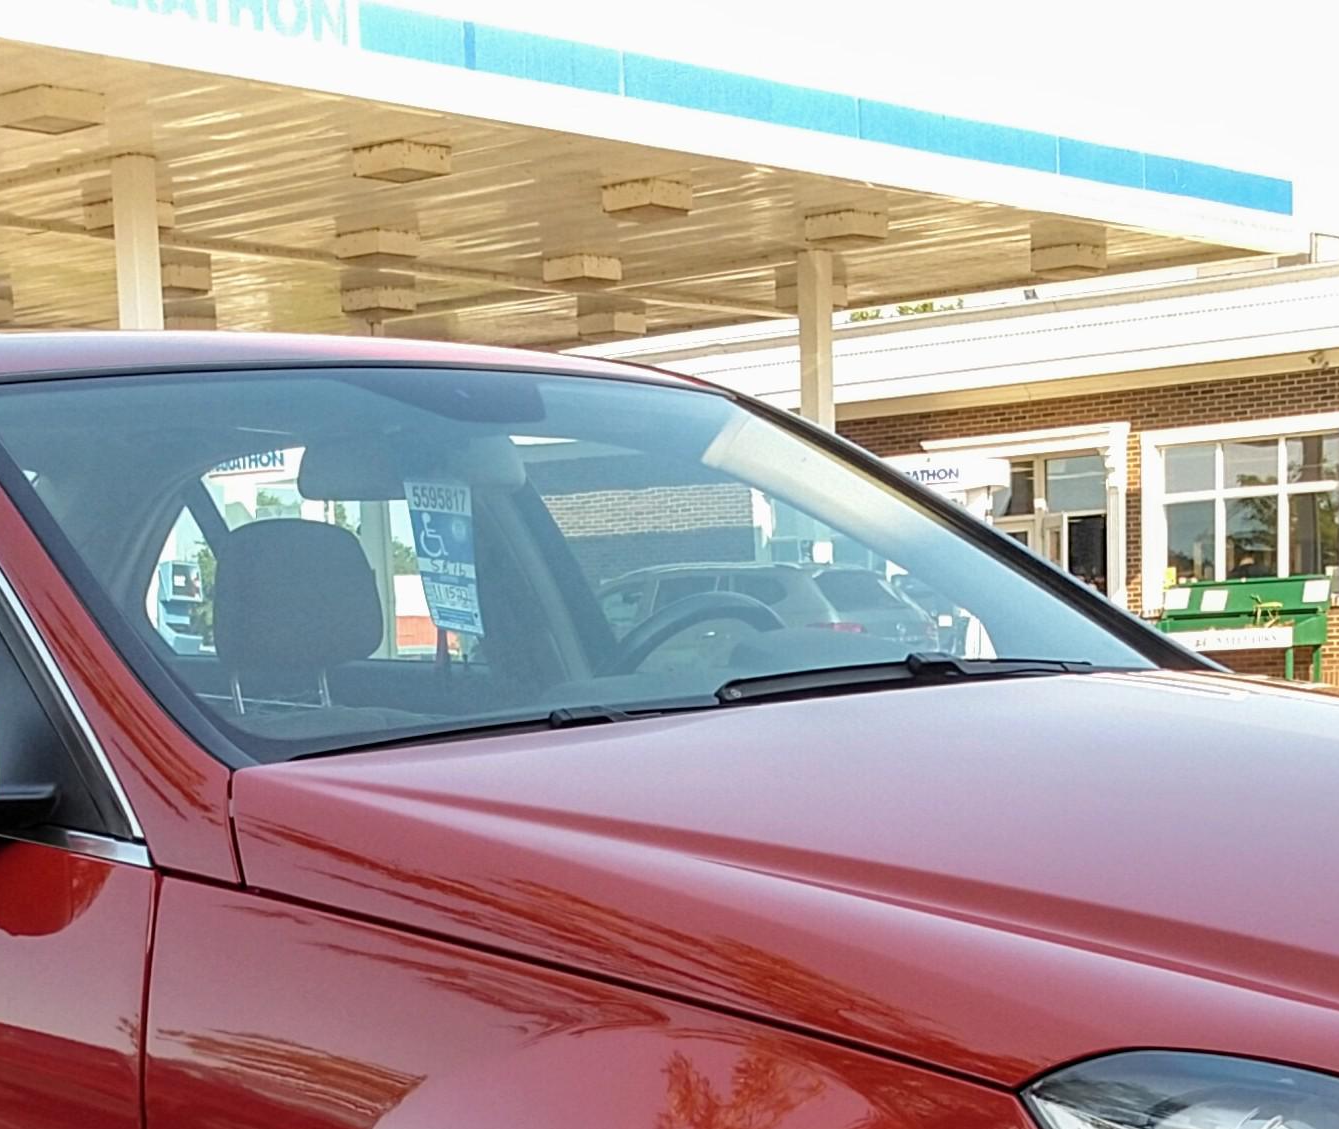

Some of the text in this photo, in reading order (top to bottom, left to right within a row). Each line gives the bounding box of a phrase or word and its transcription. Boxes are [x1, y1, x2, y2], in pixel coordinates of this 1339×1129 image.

[107, 0, 348, 46] THON
[906, 468, 959, 481] ATHON
[412, 486, 466, 512] 5595817
